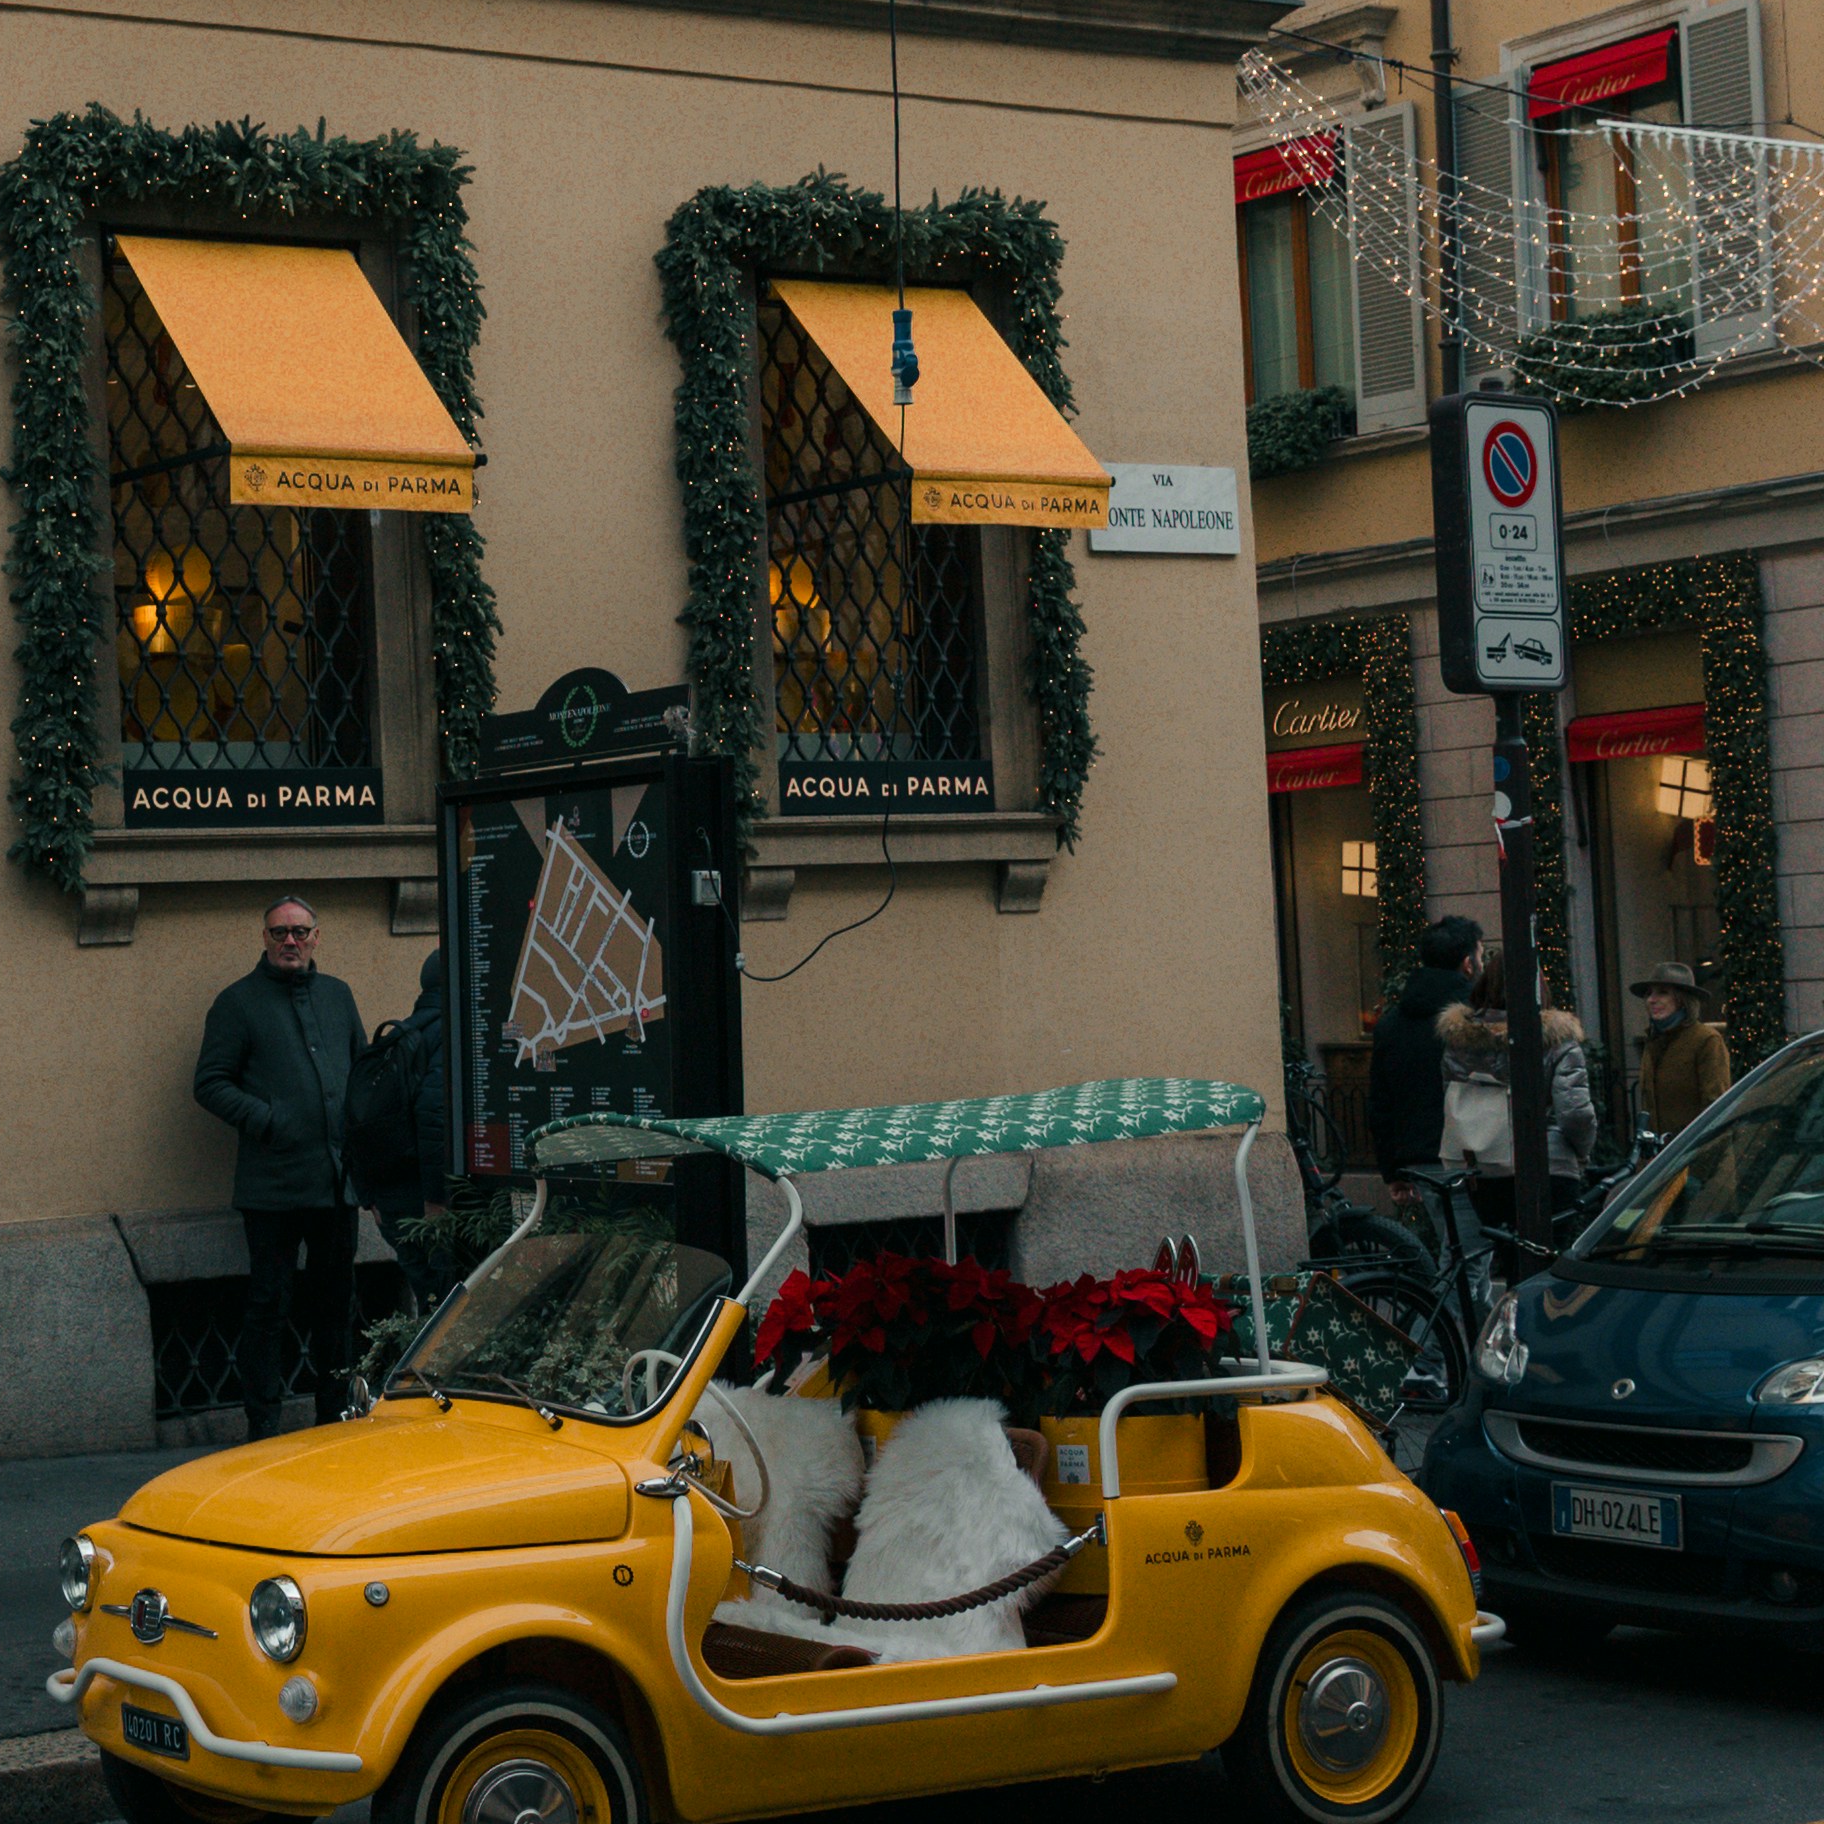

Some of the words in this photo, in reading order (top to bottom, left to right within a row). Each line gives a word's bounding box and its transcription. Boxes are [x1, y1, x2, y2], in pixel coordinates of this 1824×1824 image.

[1559, 74, 1636, 107] Cartier
[277, 471, 355, 492] ACQUA
[388, 476, 462, 496] PARMA
[1153, 474, 1174, 487] VIA
[950, 492, 1016, 510] ACQUA
[1041, 496, 1100, 514] PARMA
[1107, 507, 1146, 527] ONTE
[1152, 508, 1234, 530] NAPOLEONE
[1273, 700, 1361, 737] Cartier
[1596, 729, 1676, 757] Cartier
[786, 776, 870, 799] ACQUA
[907, 776, 989, 797] PARMA
[1275, 764, 1339, 790] Cartier
[132, 786, 233, 810] ACQUA
[278, 784, 377, 808] PARMA
[1059, 1448, 1085, 1456] ACQUA
[1145, 1550, 1190, 1565] ACQUA
[1208, 1544, 1251, 1559] PARMA
[163, 1723, 182, 1749] RC
